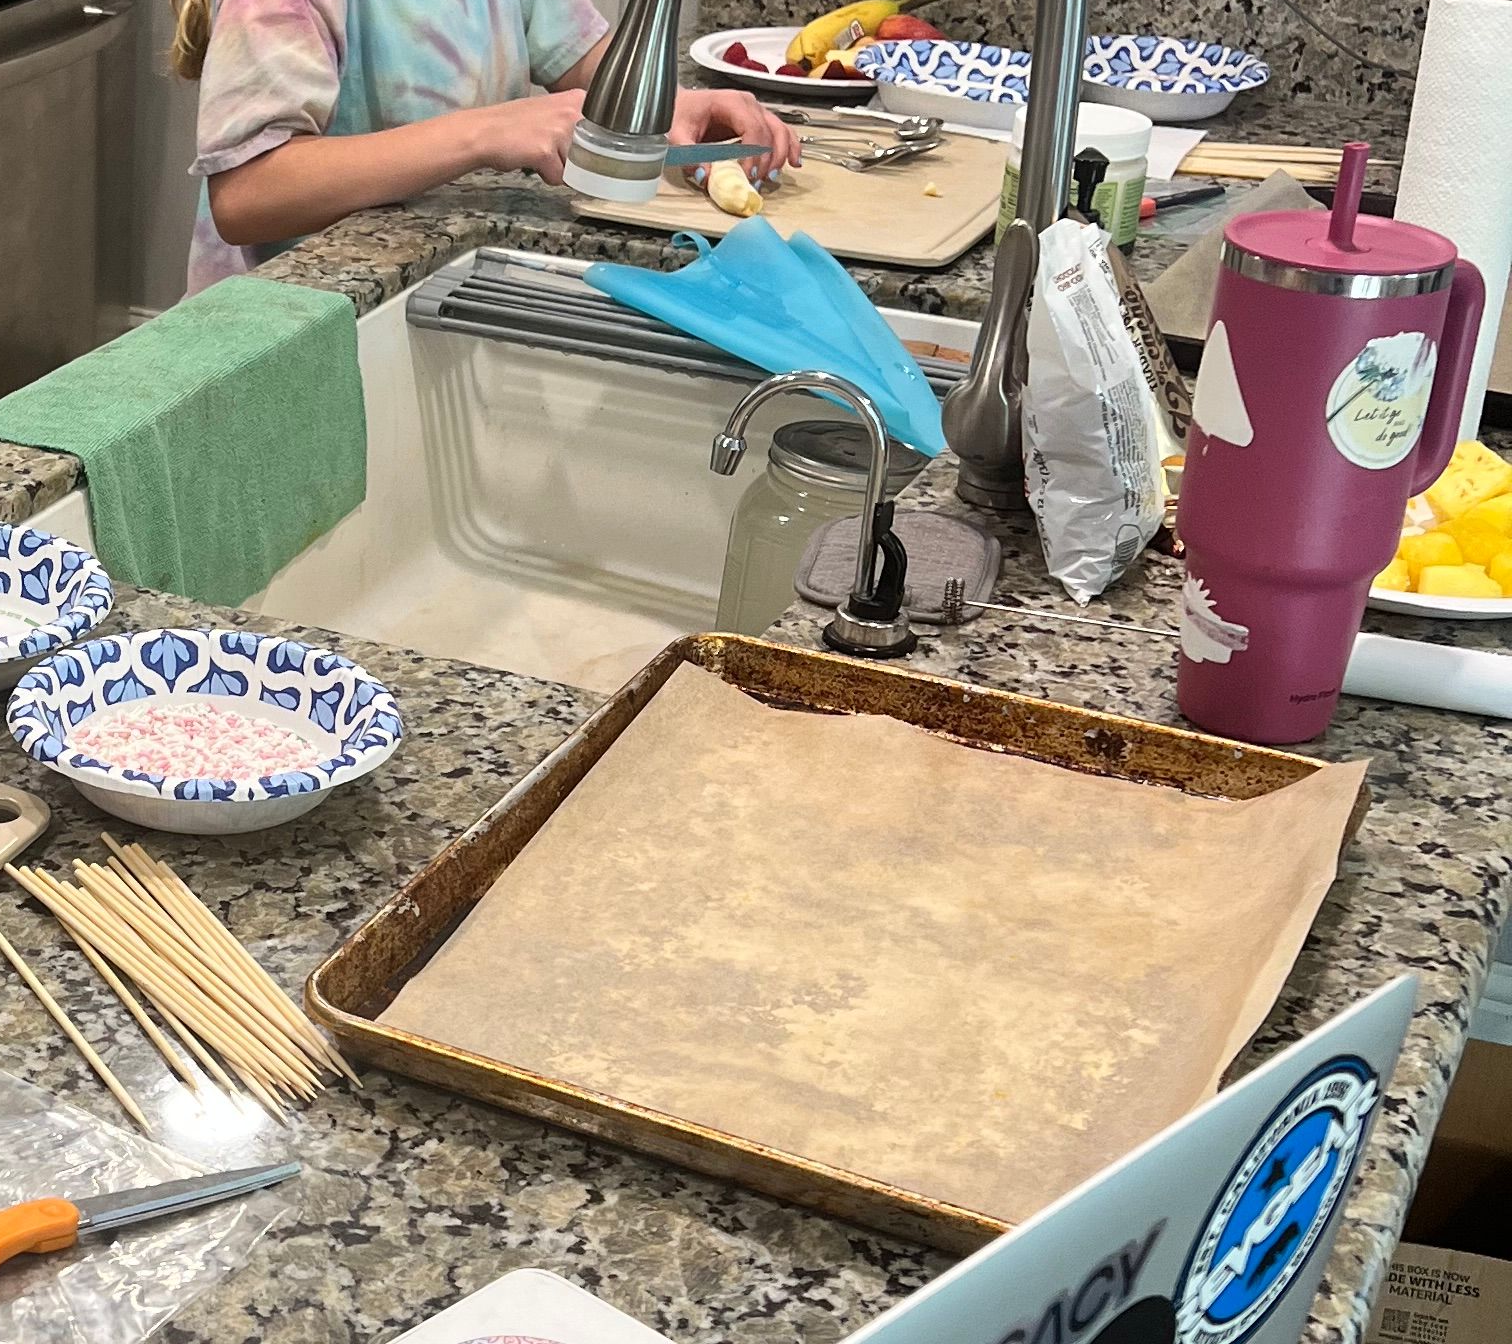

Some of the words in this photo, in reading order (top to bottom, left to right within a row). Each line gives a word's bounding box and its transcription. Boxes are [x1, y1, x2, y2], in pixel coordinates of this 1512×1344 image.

[1354, 408, 1377, 422] Let
[1175, 1078, 1378, 1338] REVGEAR
[1407, 1264, 1429, 1276] BOX
[1430, 1268, 1441, 1278] IS
[1443, 1270, 1471, 1283] NOW
[1388, 1284, 1454, 1306] MATERIAL
[1409, 1275, 1445, 1291] WITH
[1447, 1282, 1481, 1298] LESS
